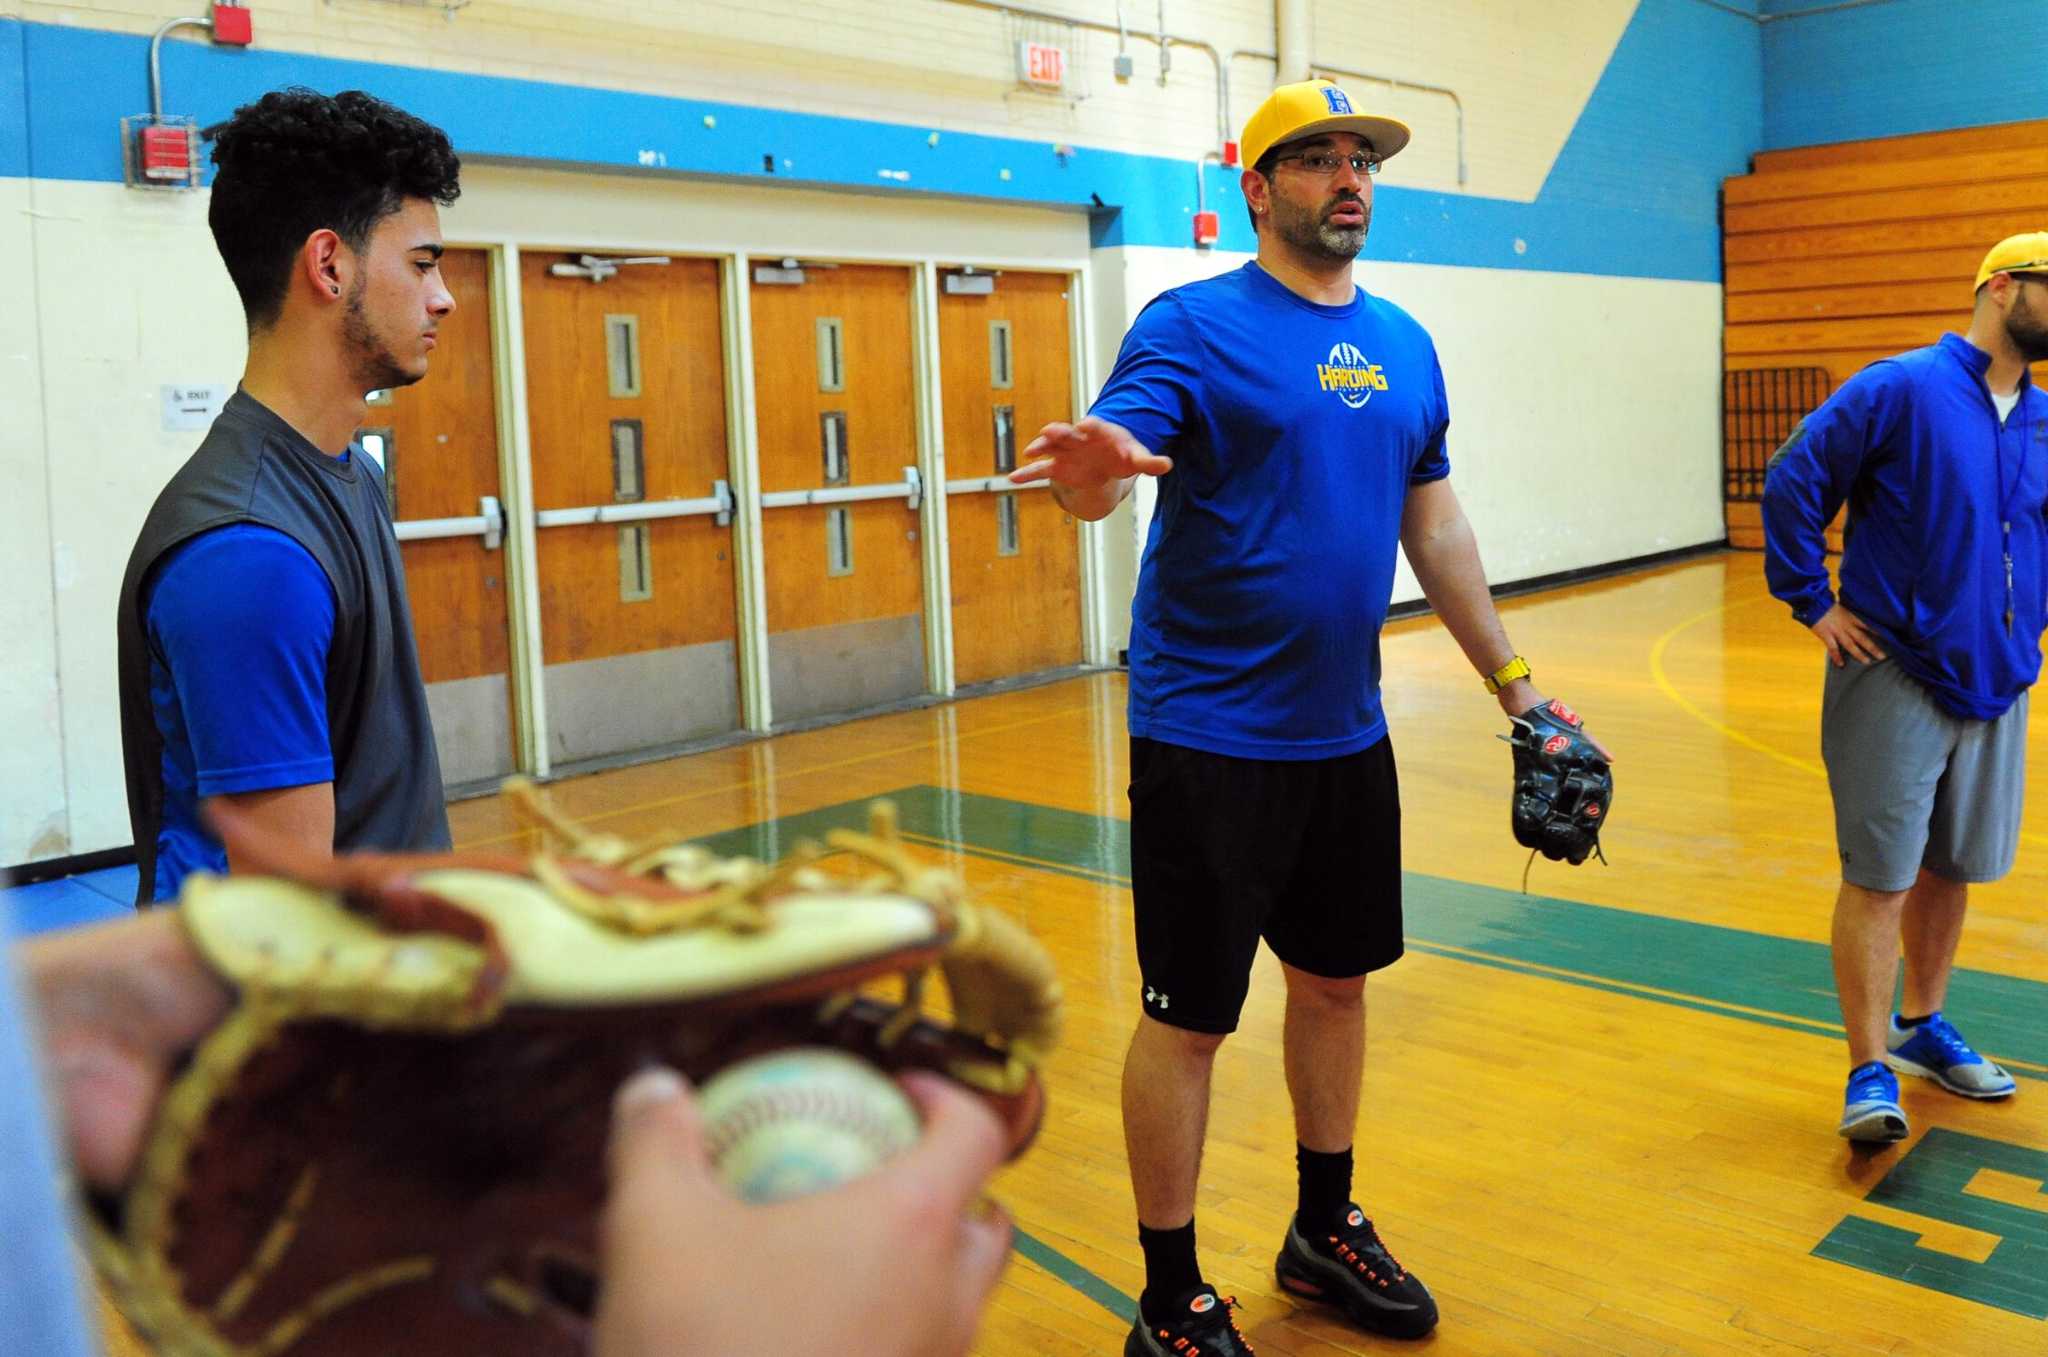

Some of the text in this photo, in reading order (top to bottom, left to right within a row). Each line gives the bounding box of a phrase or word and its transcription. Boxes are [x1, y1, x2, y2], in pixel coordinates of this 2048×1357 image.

[1029, 47, 1063, 81] EXIT
[1321, 87, 1353, 115] H
[1316, 363, 1389, 392] HARDING
[187, 390, 211, 400] EXIT
